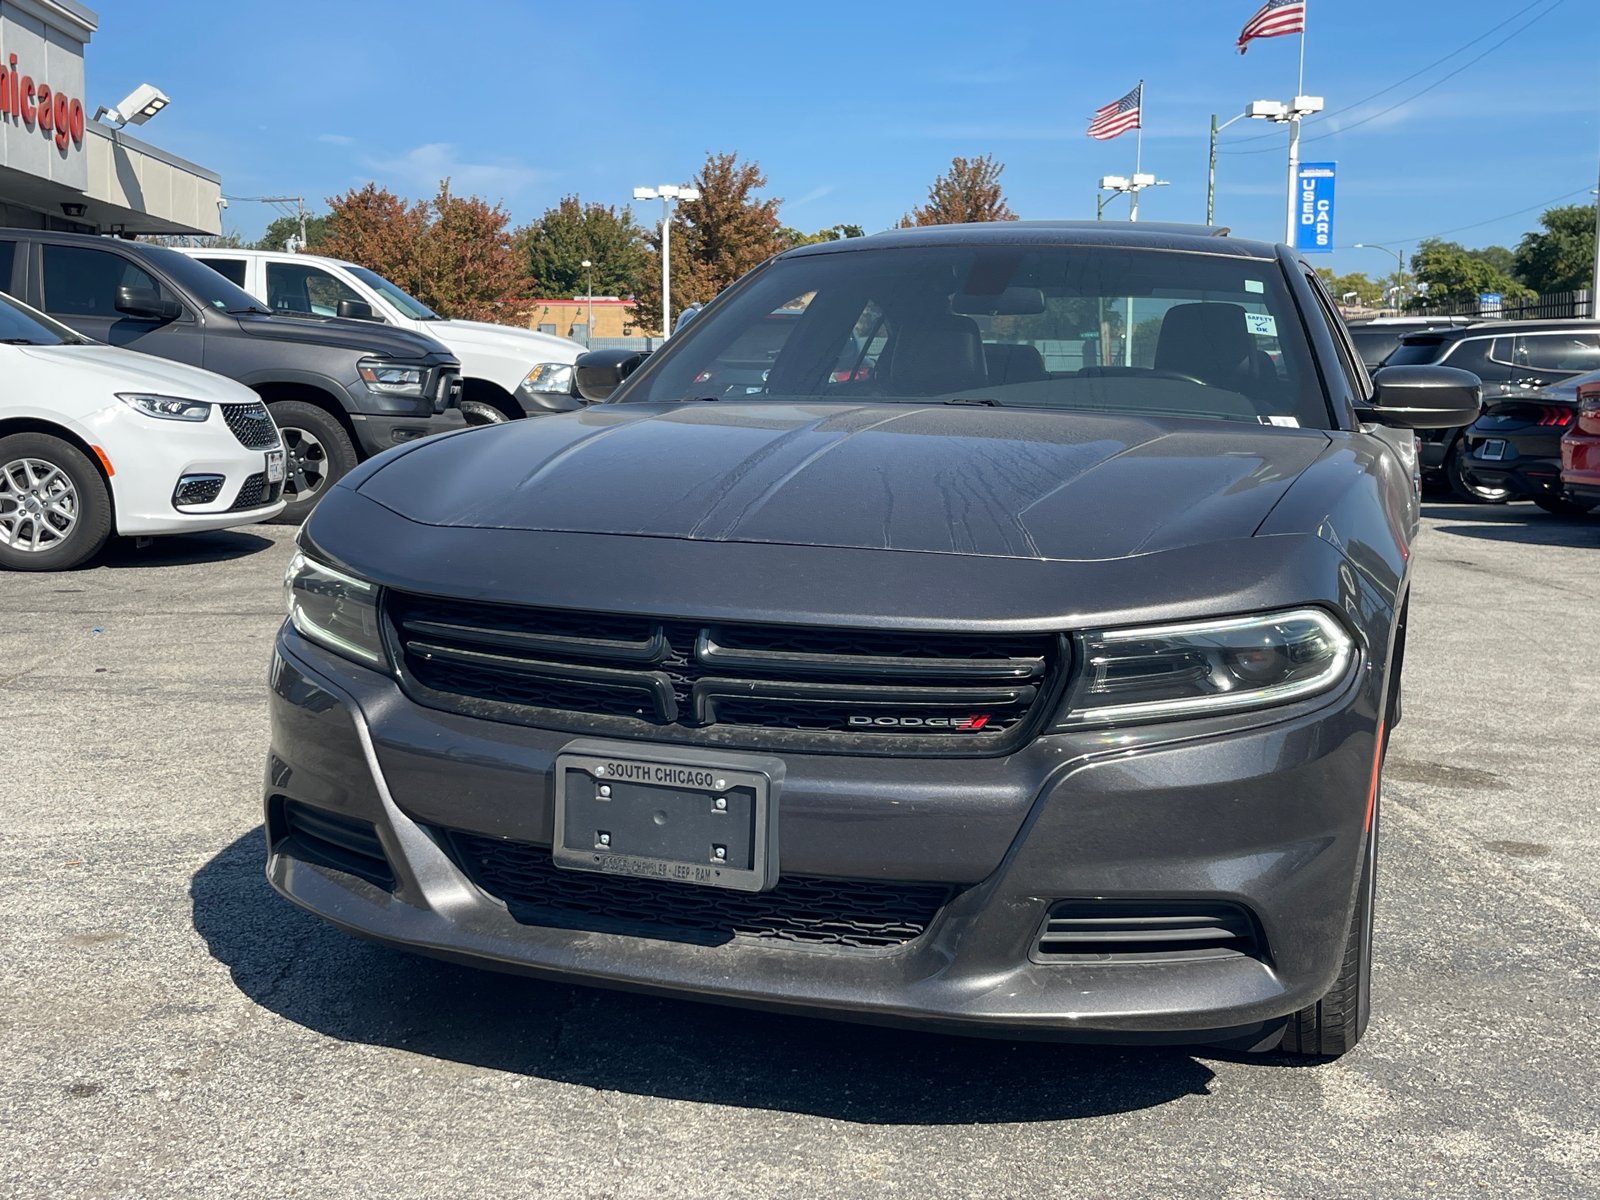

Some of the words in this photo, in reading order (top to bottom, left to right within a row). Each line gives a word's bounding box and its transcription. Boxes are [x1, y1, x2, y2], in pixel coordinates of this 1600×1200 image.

[1301, 179, 1315, 225] USED
[1316, 200, 1329, 245] CARS
[849, 715, 972, 726] DODGE
[607, 763, 651, 780] SOUTH
[655, 768, 713, 787] CHICAGO
